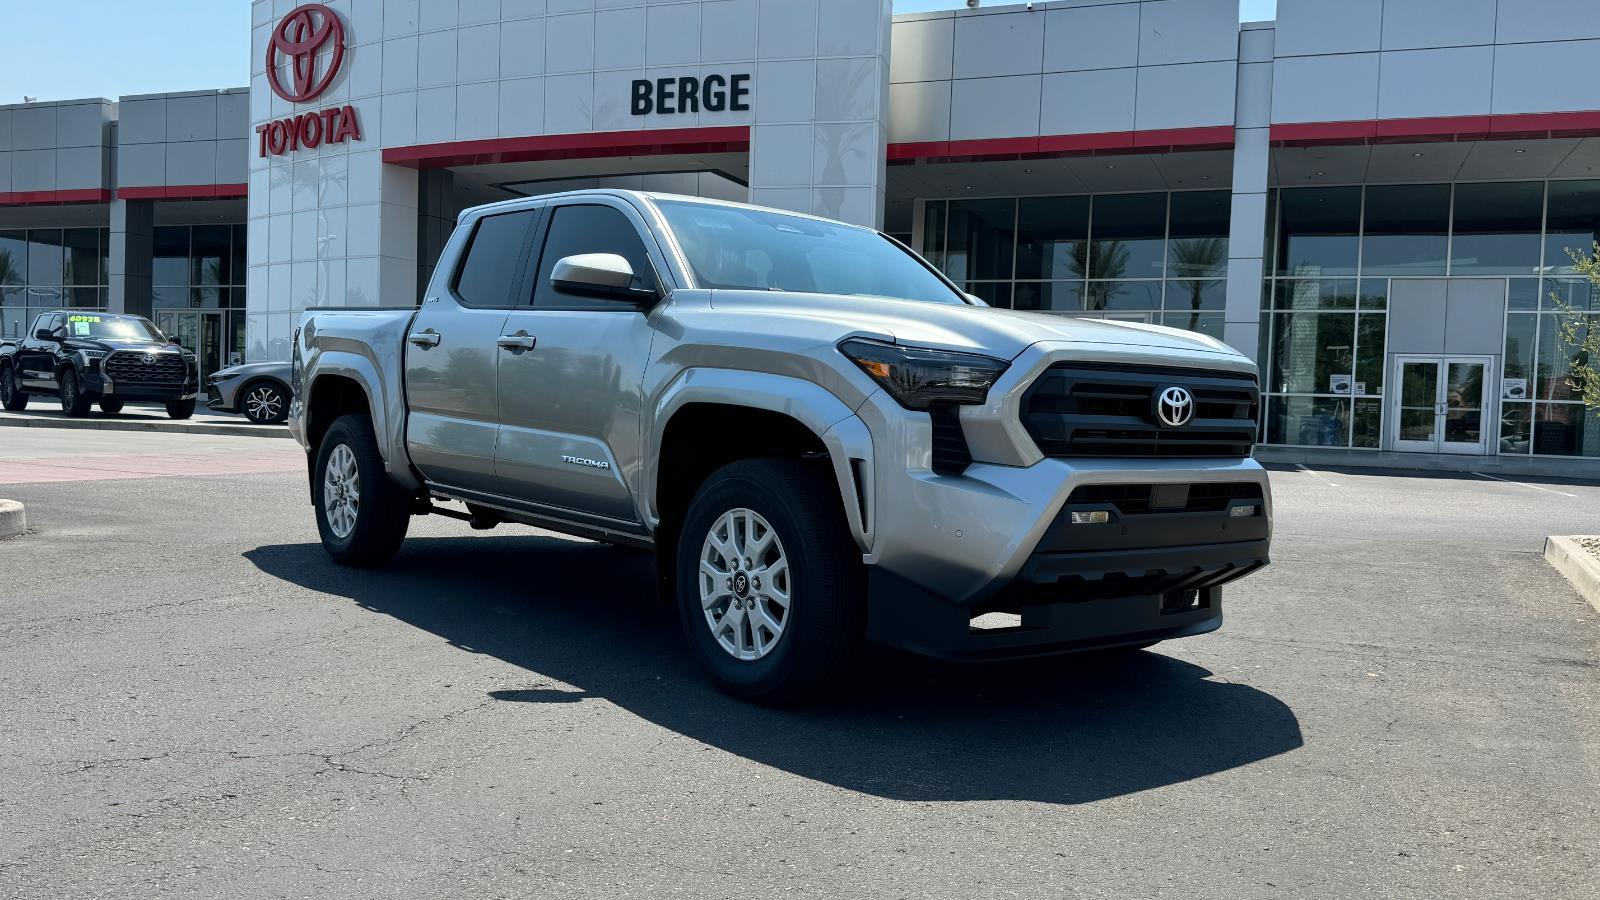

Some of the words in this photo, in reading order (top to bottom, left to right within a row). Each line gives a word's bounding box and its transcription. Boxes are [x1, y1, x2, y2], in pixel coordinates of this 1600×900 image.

[631, 74, 750, 115] BERGE
[256, 105, 361, 158] TOYOTA
[561, 455, 609, 469] TACOMA
